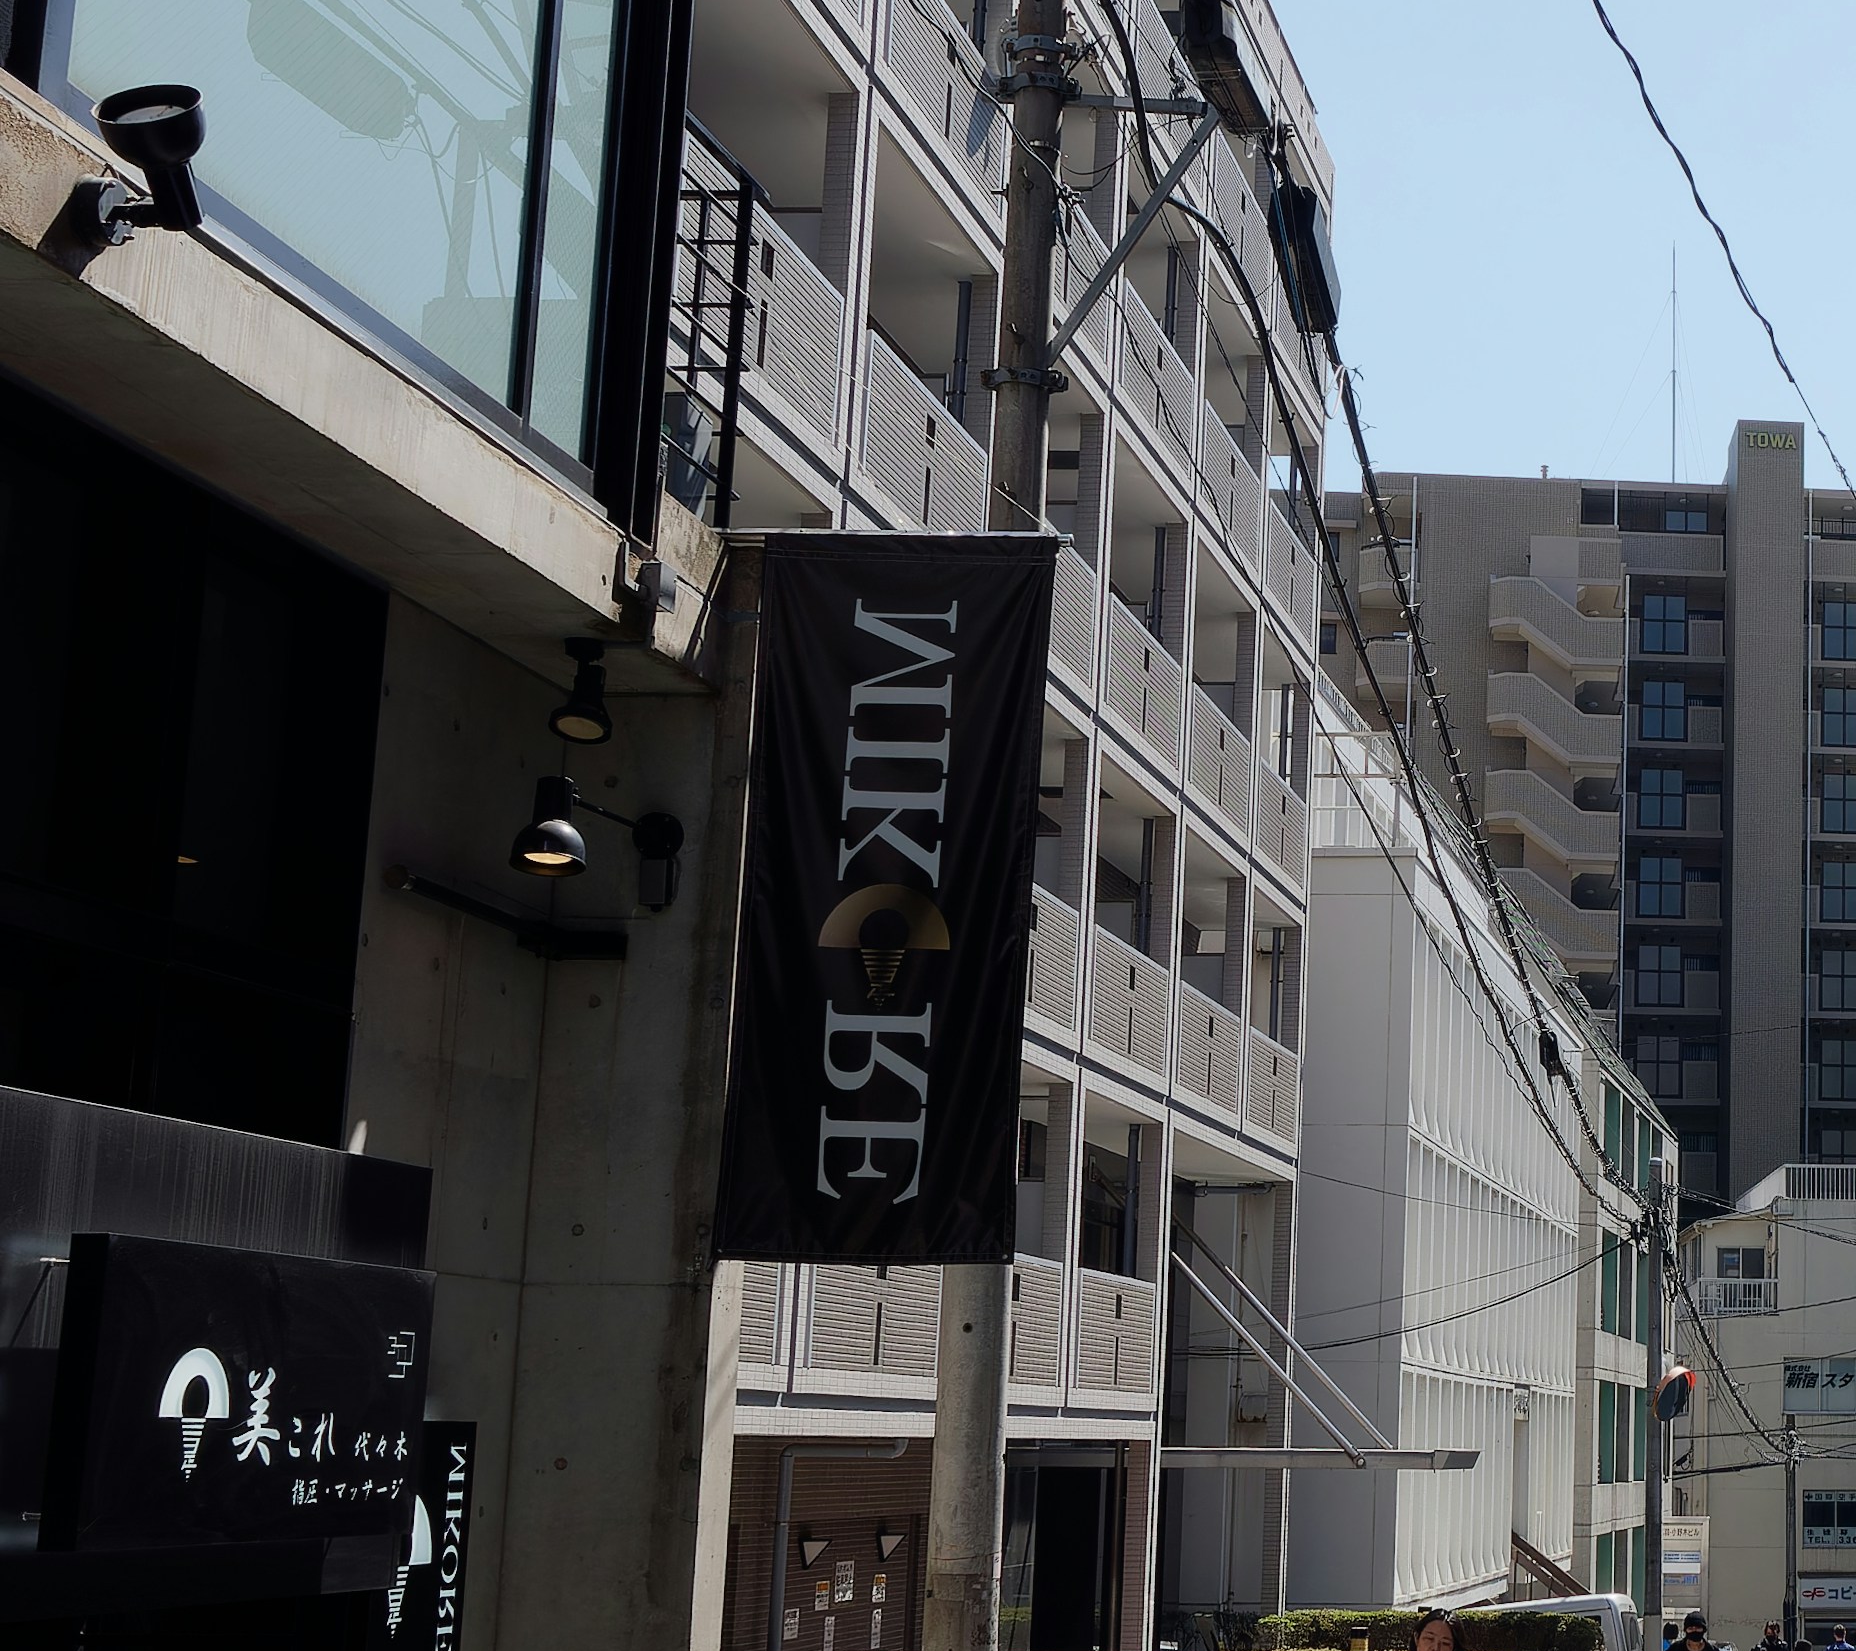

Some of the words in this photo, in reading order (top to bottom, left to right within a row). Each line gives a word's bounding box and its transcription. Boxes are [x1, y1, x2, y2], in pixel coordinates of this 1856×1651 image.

[232, 1367, 336, 1466] 美これ
[354, 1431, 409, 1461] 代々木
[292, 1478, 403, 1506] 指圧・マッサージ
